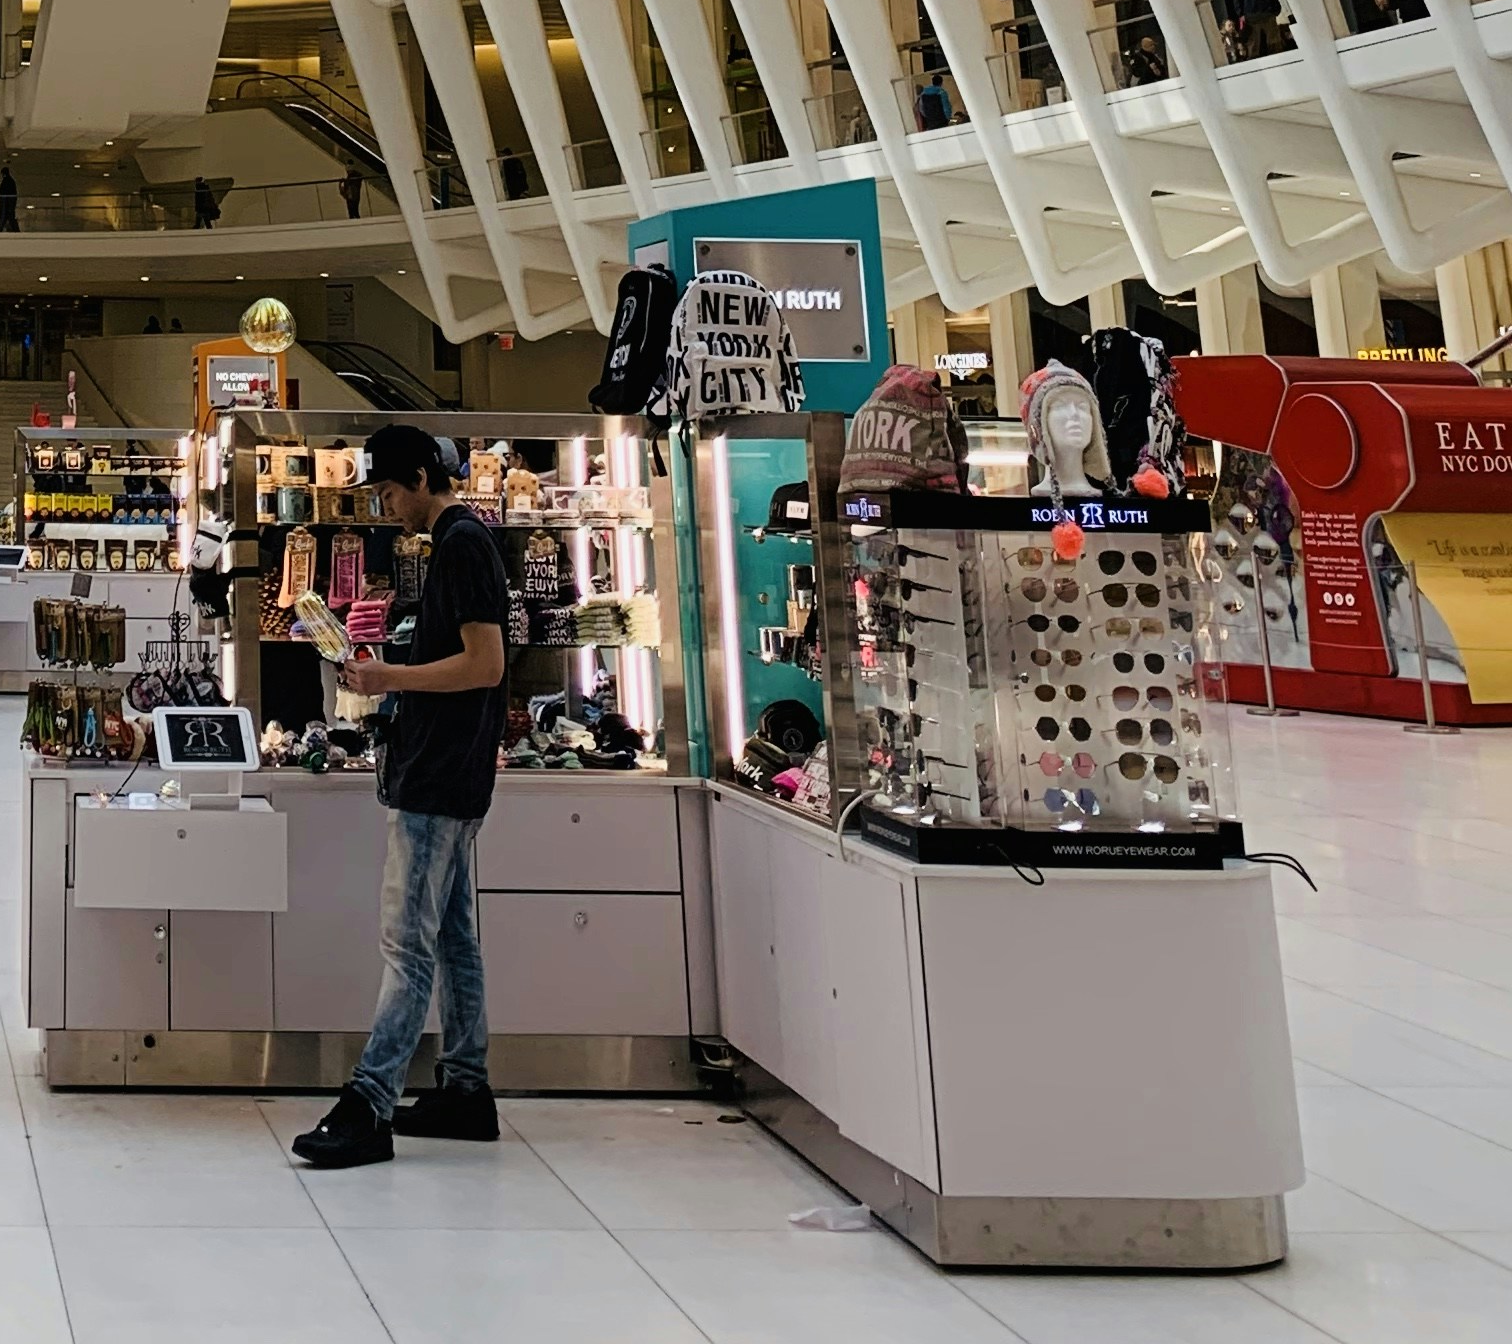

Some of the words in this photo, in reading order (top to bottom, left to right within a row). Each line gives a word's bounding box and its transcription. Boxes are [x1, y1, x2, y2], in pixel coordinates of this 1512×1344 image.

[700, 290, 767, 326] NEW
[787, 290, 841, 310] RUTH
[934, 353, 988, 369] LONGINES
[216, 372, 227, 381] NO
[230, 372, 263, 382] CHEW
[701, 367, 766, 404] CITY
[222, 383, 250, 391] ALLOW
[855, 412, 920, 453] YORK
[1435, 422, 1506, 450] EAT
[1442, 455, 1478, 472] NYC
[1032, 509, 1076, 522] ROBN
[1108, 510, 1148, 524] RUTH
